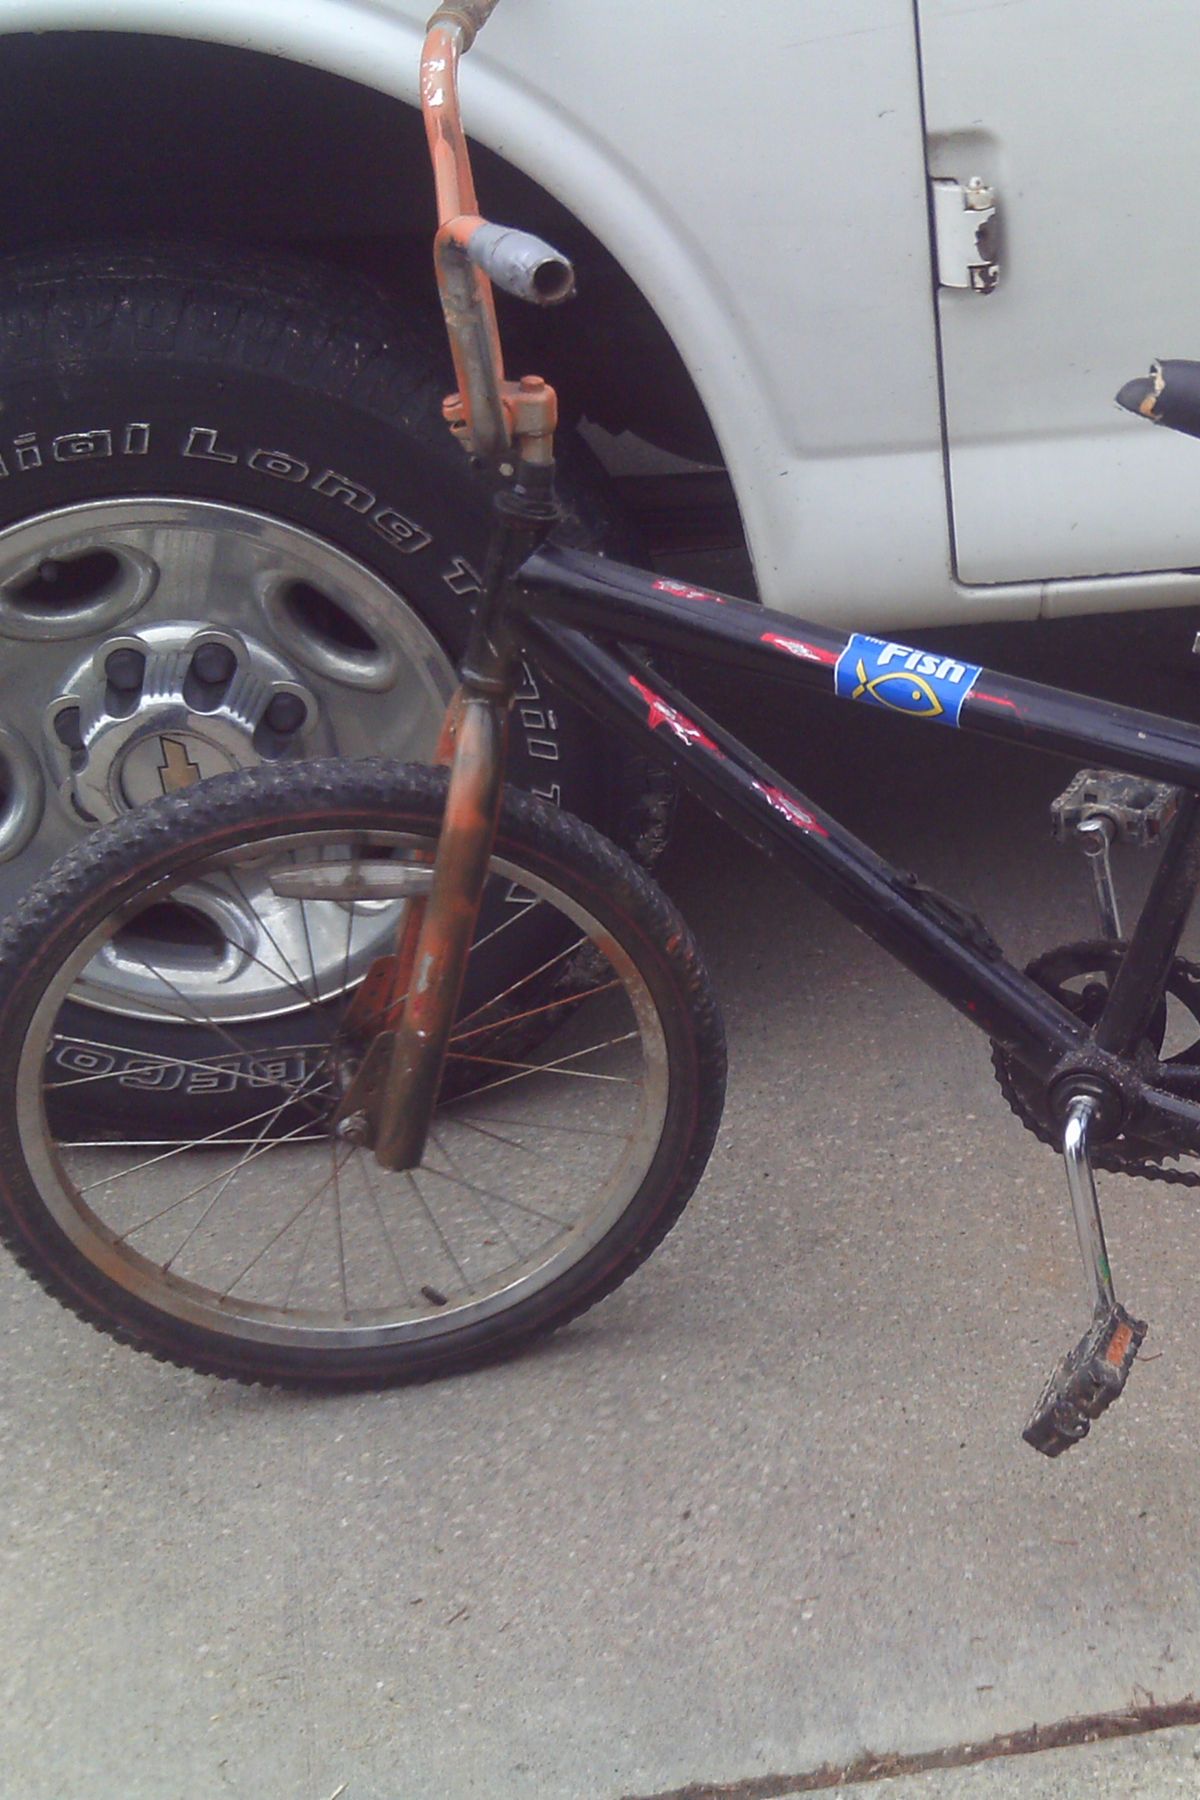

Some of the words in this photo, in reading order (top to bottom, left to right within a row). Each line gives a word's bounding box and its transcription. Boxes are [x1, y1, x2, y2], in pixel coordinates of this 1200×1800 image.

[0, 423, 150, 476] ial
[182, 426, 433, 553] Long
[877, 642, 966, 682] Fish
